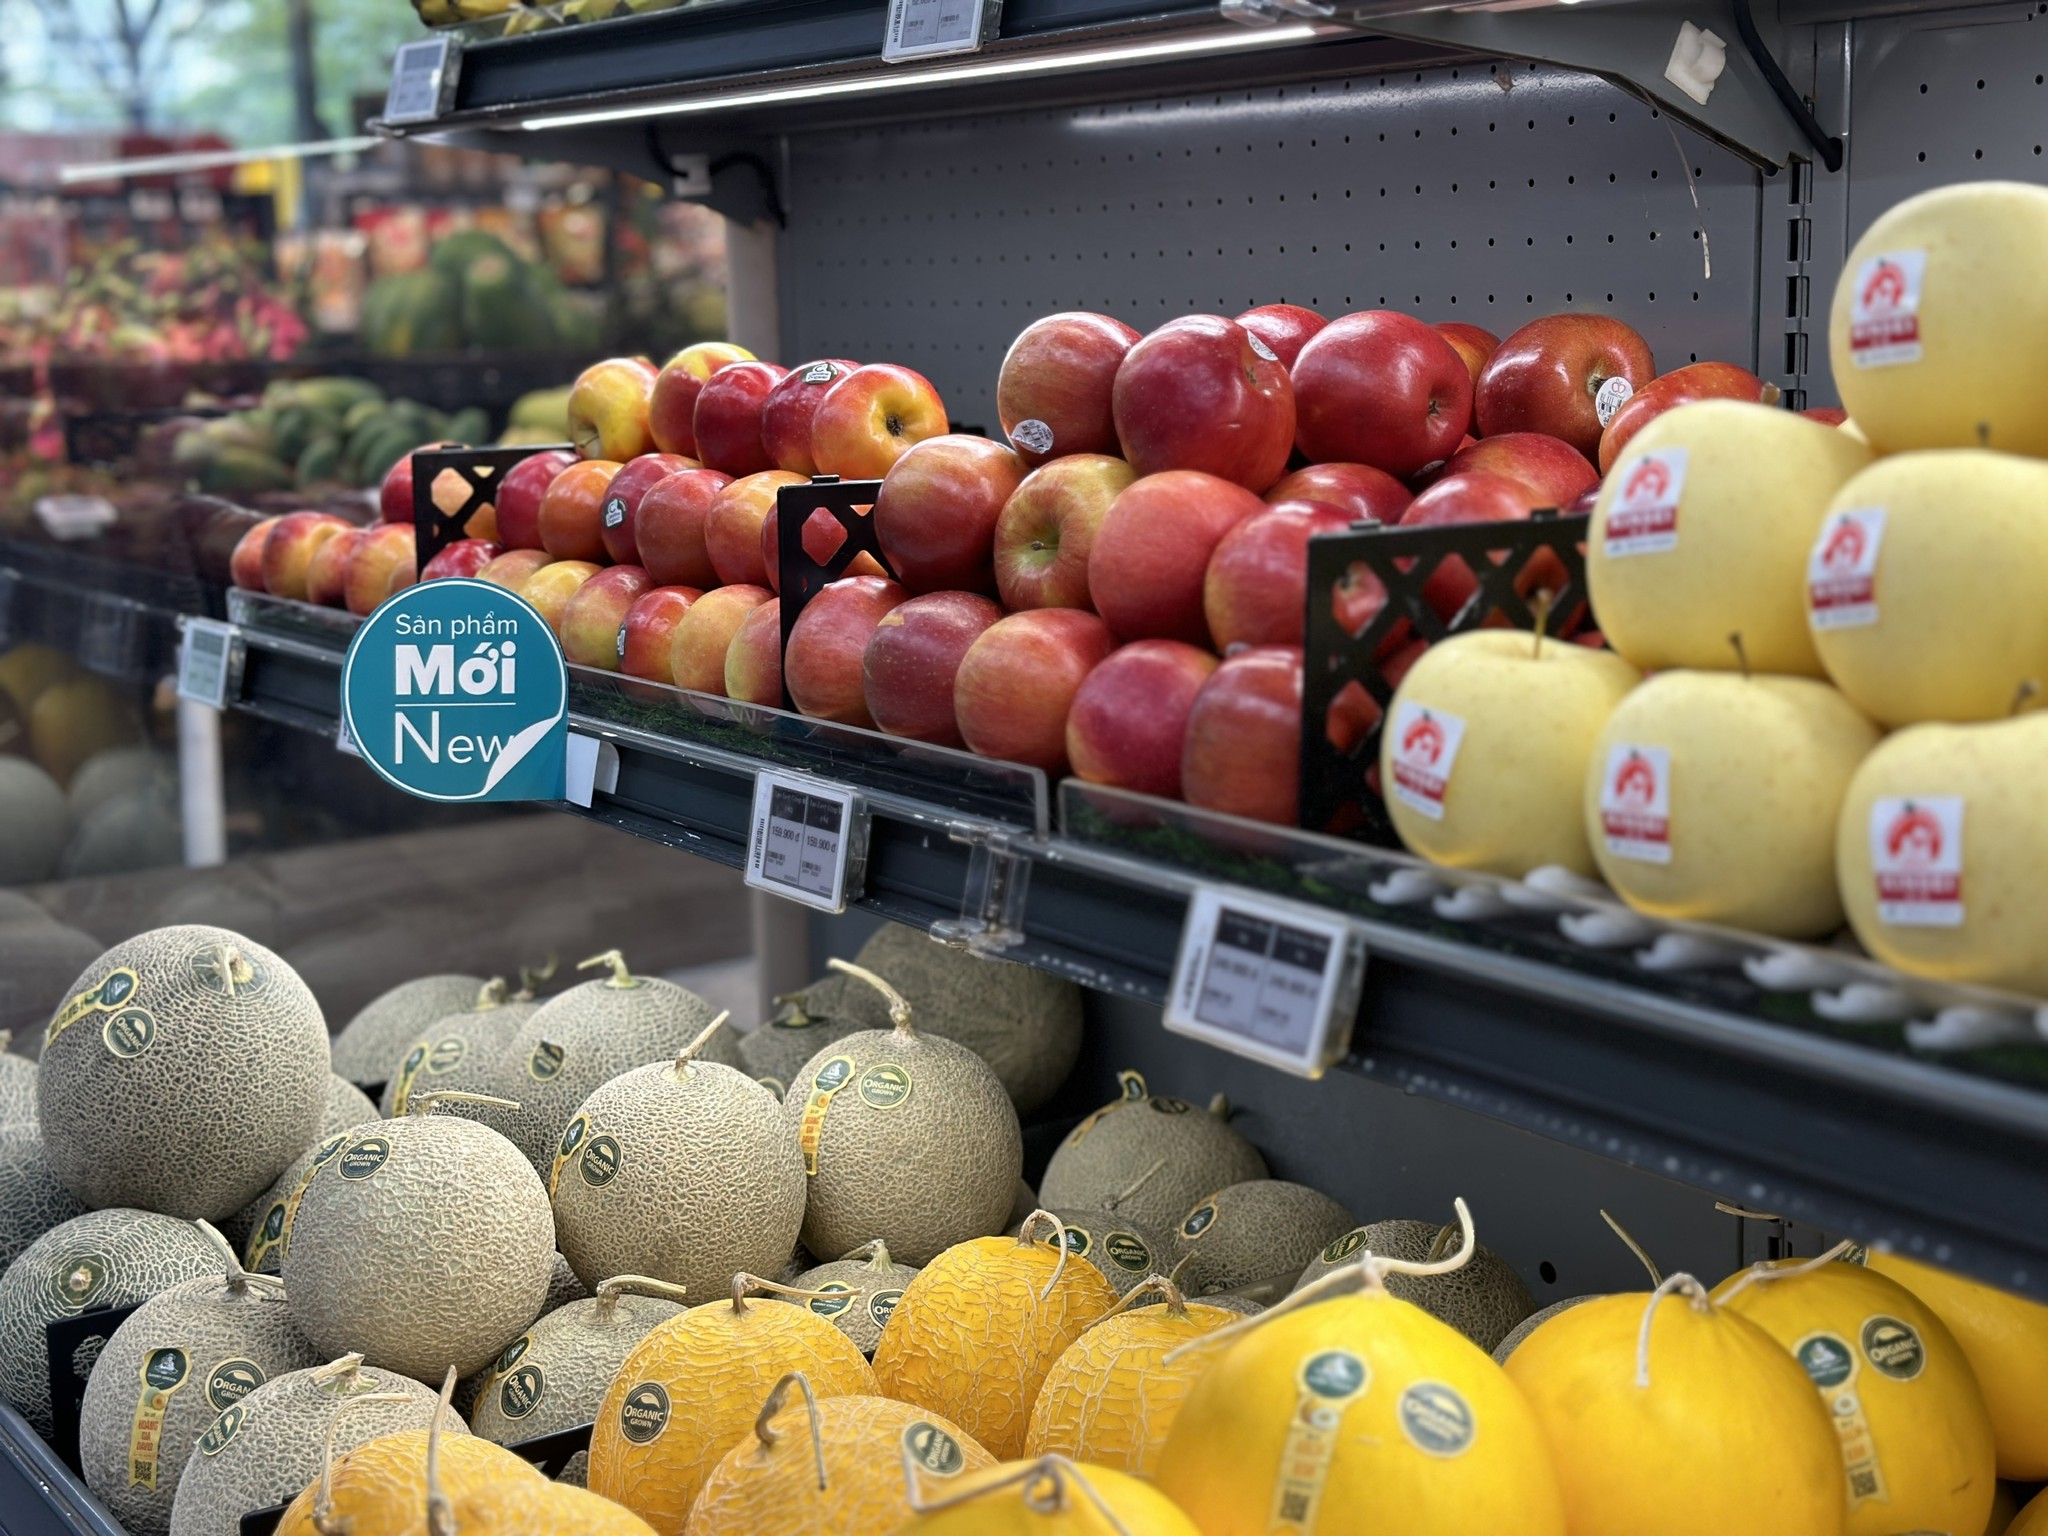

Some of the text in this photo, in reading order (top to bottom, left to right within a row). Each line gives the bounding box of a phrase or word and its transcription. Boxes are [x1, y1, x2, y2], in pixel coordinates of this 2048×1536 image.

[395, 611, 518, 639] Sản phẩm
[395, 641, 516, 695] Mới
[395, 711, 515, 764] New
[117, 1017, 143, 1050] ORGANIC
[865, 1079, 905, 1093] ORGANIC
[872, 1088, 894, 1096] GROWN
[345, 1153, 384, 1162] ORGANIC
[586, 1149, 614, 1175] ORGANIC
[1110, 1247, 1146, 1257] ORGANIC
[1870, 1338, 1917, 1361] ORGANIC
[213, 1377, 250, 1394] ORGAN
[220, 1390, 243, 1400] GROW
[509, 1374, 531, 1409] ORGANIC
[625, 1404, 664, 1421] ORGANIC
[630, 1418, 653, 1428] GROWN
[926, 1430, 944, 1467] ORGANIC
